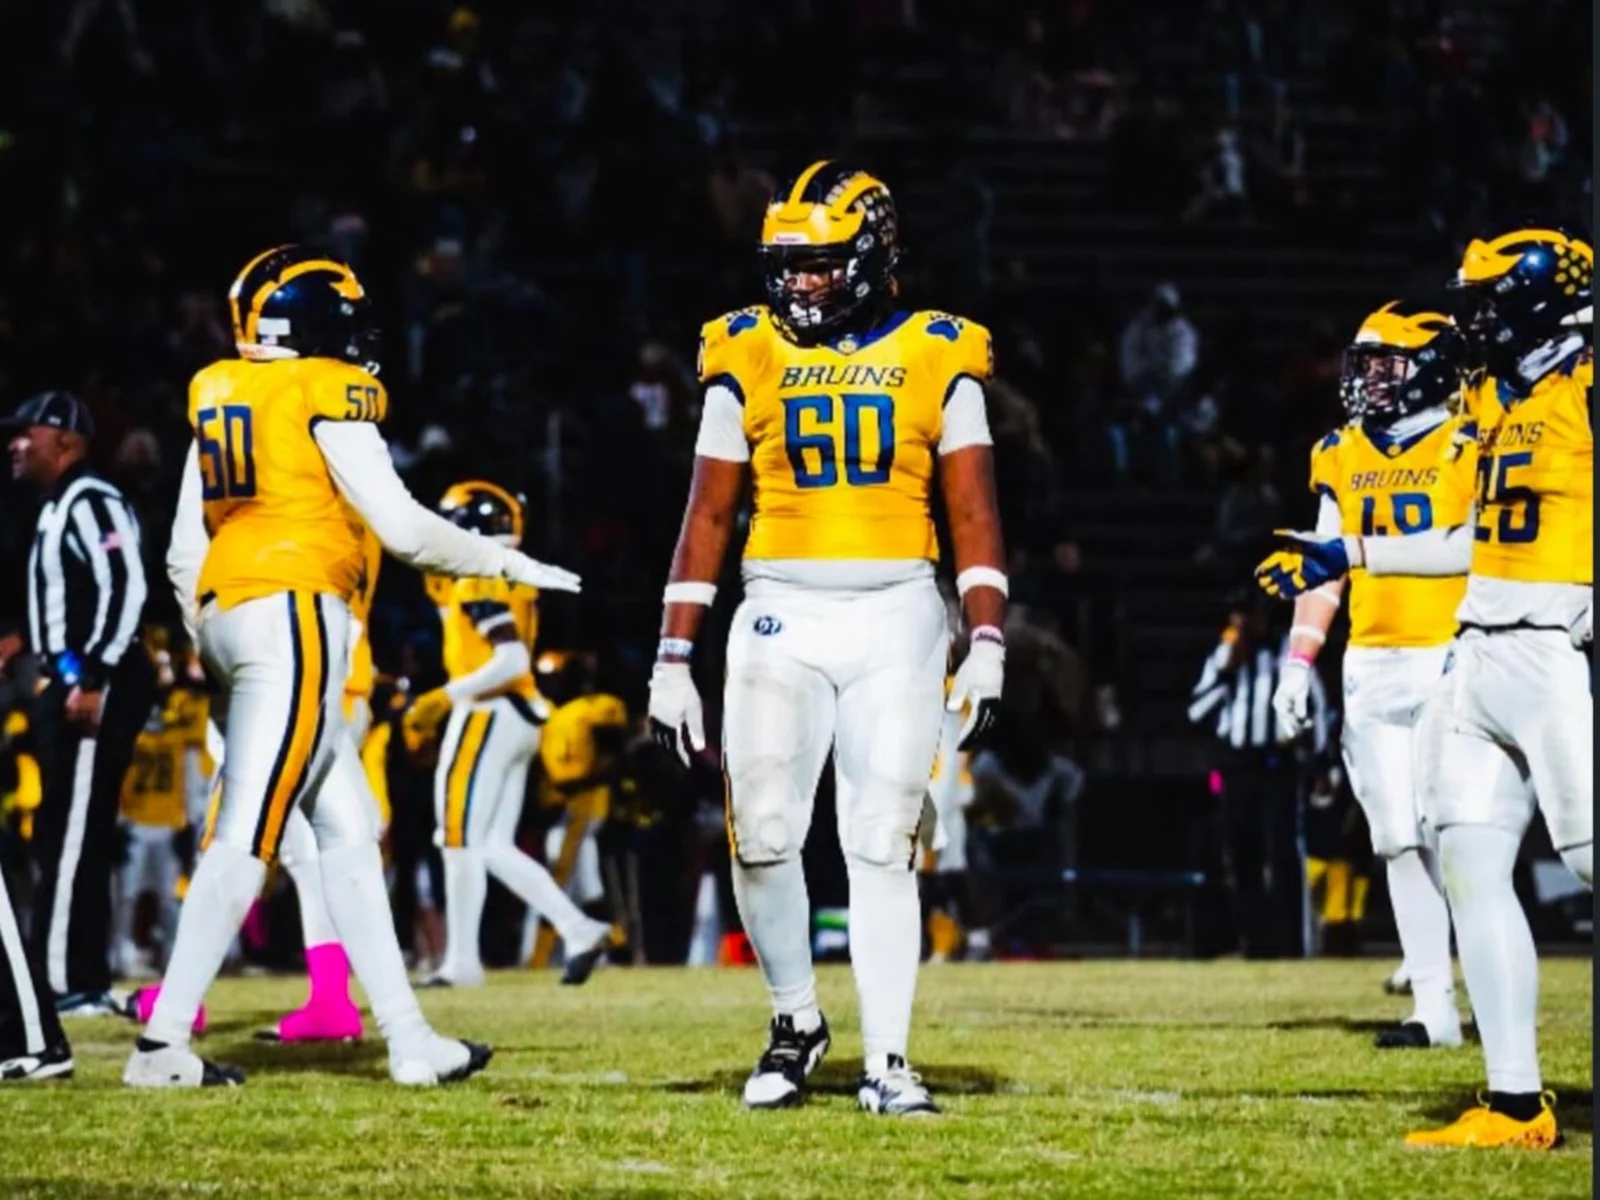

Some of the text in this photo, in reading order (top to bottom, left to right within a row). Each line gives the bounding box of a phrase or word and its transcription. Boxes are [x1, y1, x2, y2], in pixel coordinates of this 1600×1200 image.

[779, 365, 907, 389] BRUINS
[344, 384, 378, 420] 50
[198, 405, 256, 498] 50
[780, 393, 895, 488] 60
[1351, 467, 1440, 490] BRUINS
